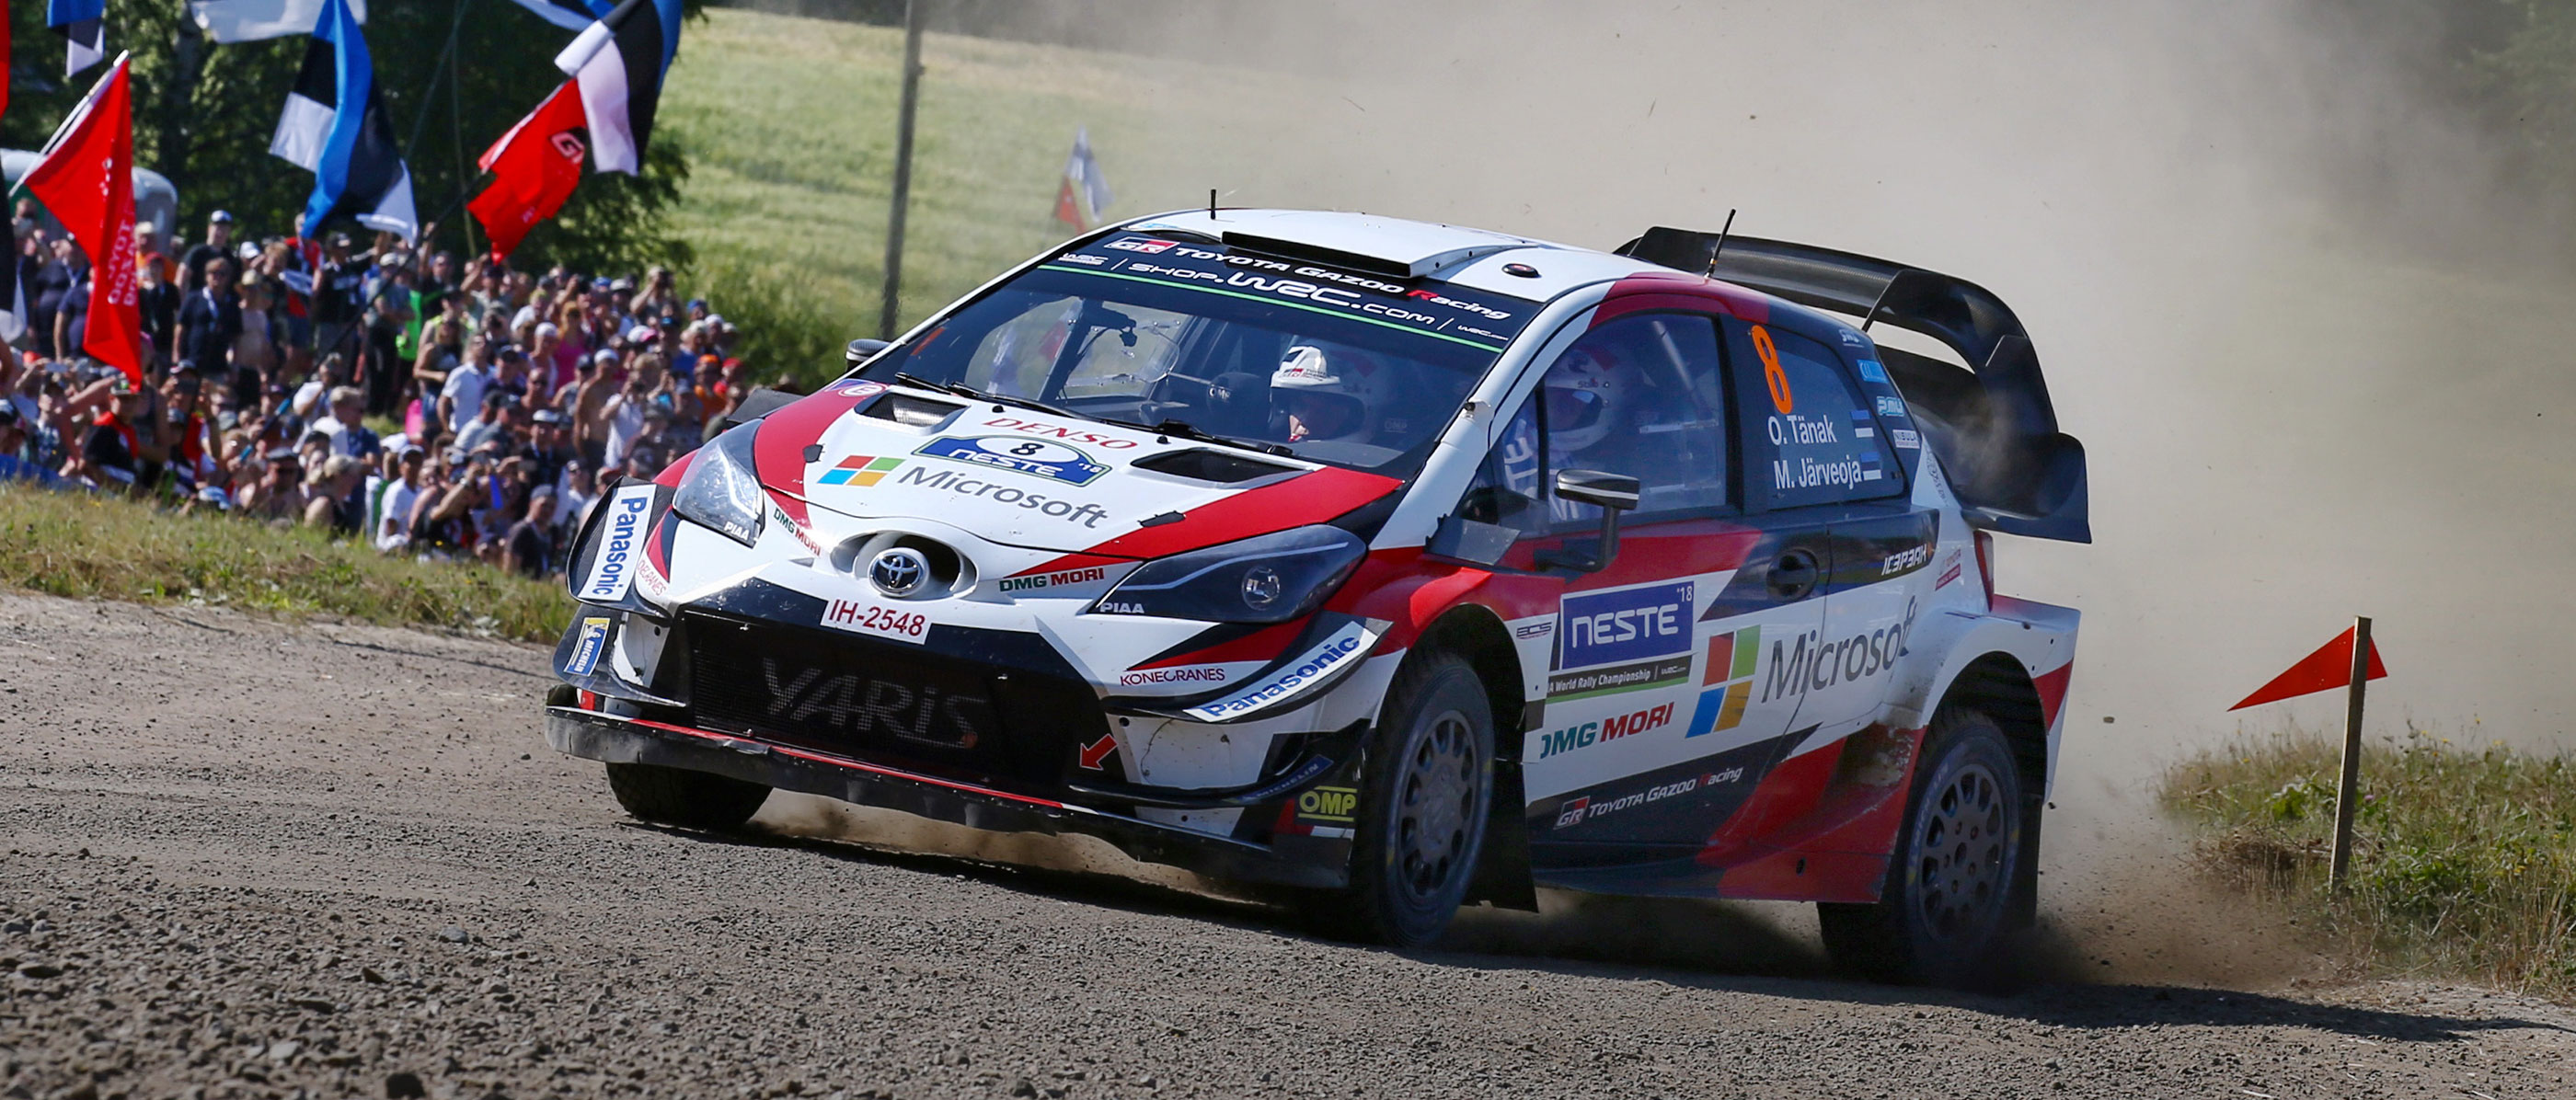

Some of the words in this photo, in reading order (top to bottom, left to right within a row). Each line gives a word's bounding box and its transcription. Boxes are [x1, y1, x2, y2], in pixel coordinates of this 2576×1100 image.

[1175, 247, 1291, 272] TOYOTA
[1294, 267, 1405, 293] GAZOO
[1407, 290, 1511, 321] Racing
[1751, 324, 1793, 414] 8
[983, 418, 1138, 450] DENSO
[1767, 416, 1788, 446] O.
[1787, 414, 1837, 444] Tänak
[1009, 442, 1045, 456] 8
[1773, 460, 1795, 489] M.
[1798, 454, 1863, 489] Järveoja
[896, 466, 1110, 529] Microsoft
[592, 497, 647, 596] Panasonic
[724, 521, 750, 541] PIAA
[774, 507, 795, 533] DMG
[795, 527, 822, 556] MORI
[998, 575, 1048, 592] DMG
[1051, 567, 1105, 587] MORI
[828, 599, 926, 637] IH-2548
[1099, 602, 1145, 614] PIAA
[1570, 603, 1679, 648] NESTE
[574, 639, 595, 672] MICHELIN
[1120, 668, 1225, 687] KONECRANES
[1198, 636, 1361, 719] Panasonic
[1555, 679, 1577, 692] World
[1577, 675, 1596, 691] Rally
[1598, 670, 1650, 686] Championship
[1600, 702, 1675, 743] MORI
[1299, 790, 1356, 816] OMP
[1556, 808, 1585, 827] GR
[1589, 794, 1643, 819] TOYOTA
[1646, 778, 1697, 803] GAZOO
[1698, 767, 1743, 788] Racing
